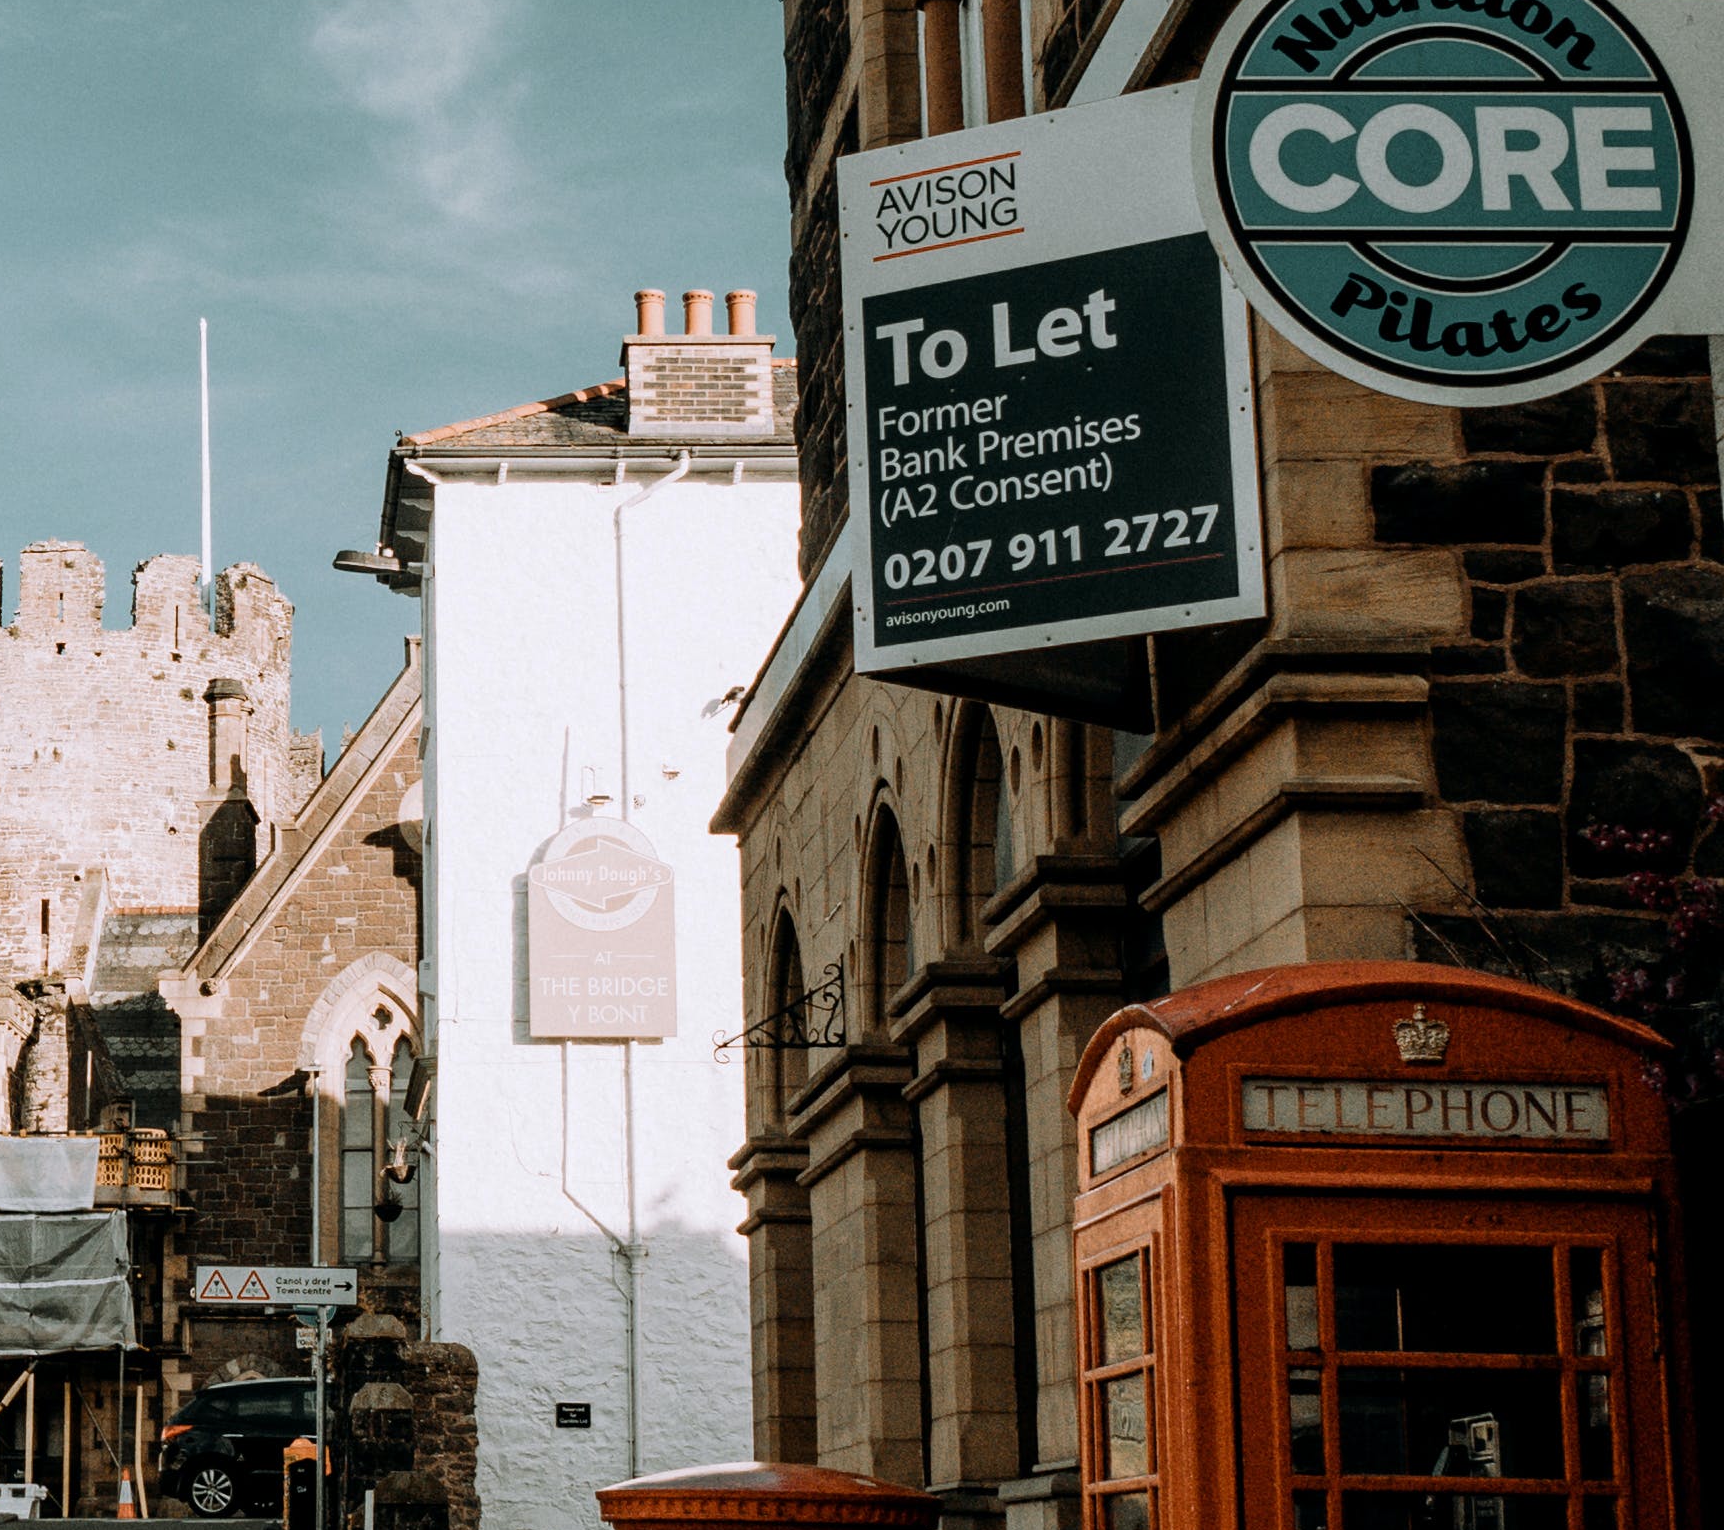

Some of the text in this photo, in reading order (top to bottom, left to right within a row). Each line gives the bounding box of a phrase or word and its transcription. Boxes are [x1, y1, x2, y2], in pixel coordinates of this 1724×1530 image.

[1249, 102, 1663, 213] CORE
[876, 162, 1017, 220] AVISON
[876, 197, 1018, 250] YOUNG
[876, 288, 1118, 387] To Let
[1330, 272, 1602, 358] Pilates
[878, 394, 1008, 441] Former
[880, 413, 1141, 482] Bank Premises
[880, 452, 1114, 528] (A2 Consent)
[884, 504, 1220, 590] 0207 911 2727
[885, 597, 1011, 628] avisonyoung.com
[541, 865, 662, 886] Johnny Dough's
[594, 951, 613, 965] AT
[540, 977, 669, 997] THE BRIDGE
[567, 1005, 649, 1024] Y BONT
[1254, 1081, 1592, 1134] TELEPHONE
[276, 1276, 331, 1287] Canol y dref
[276, 1286, 332, 1296] Town centre
